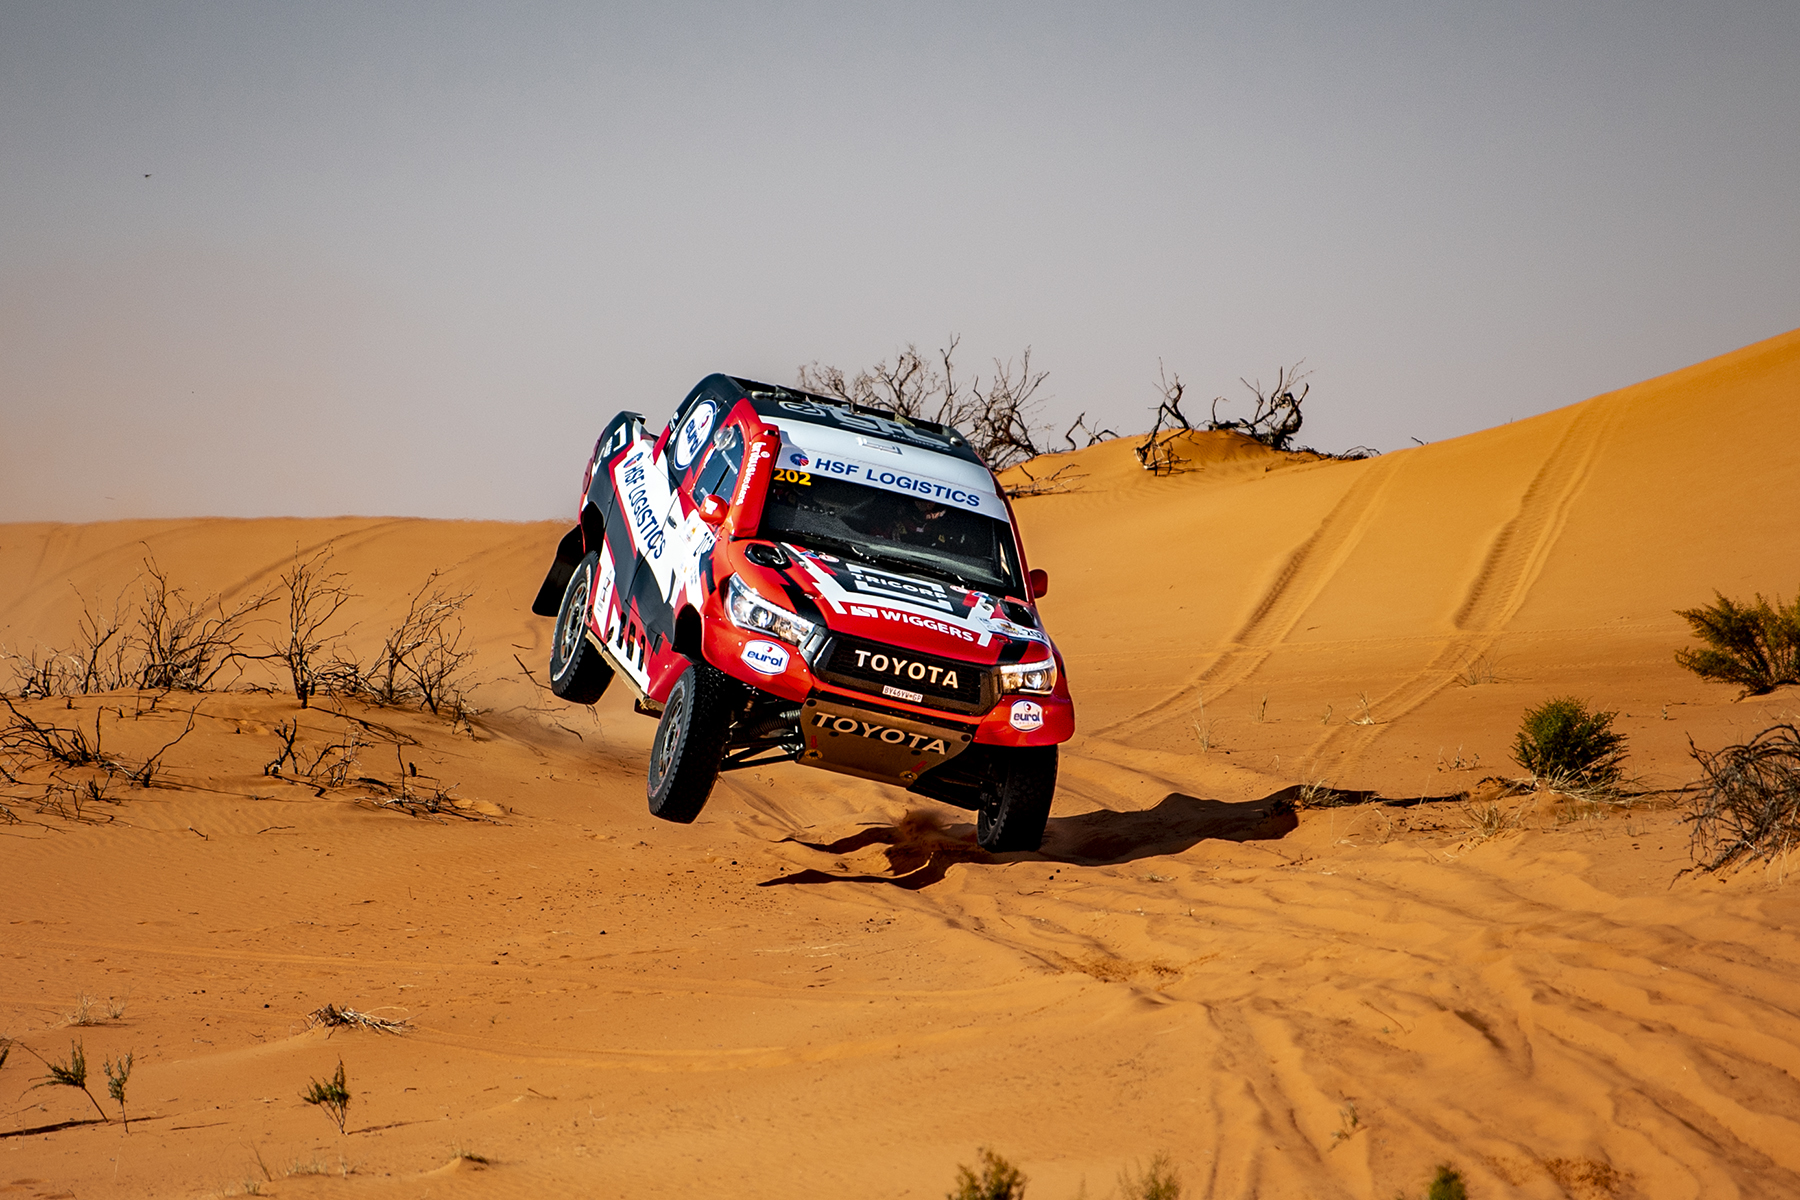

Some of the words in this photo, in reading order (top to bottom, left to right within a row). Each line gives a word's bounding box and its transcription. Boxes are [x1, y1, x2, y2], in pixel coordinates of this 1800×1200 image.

[624, 462, 645, 486] HSF
[773, 467, 812, 487] 202
[815, 458, 859, 476] HSF
[866, 468, 981, 507] LOGISTICS
[628, 483, 666, 559] LOGISTICS
[850, 572, 948, 600] TRICORP
[881, 609, 975, 643] WIGGERS
[747, 650, 783, 667] eurol
[854, 649, 959, 689] TOYOTA
[1013, 711, 1040, 722] eurol
[815, 711, 947, 756] TOYOTA
